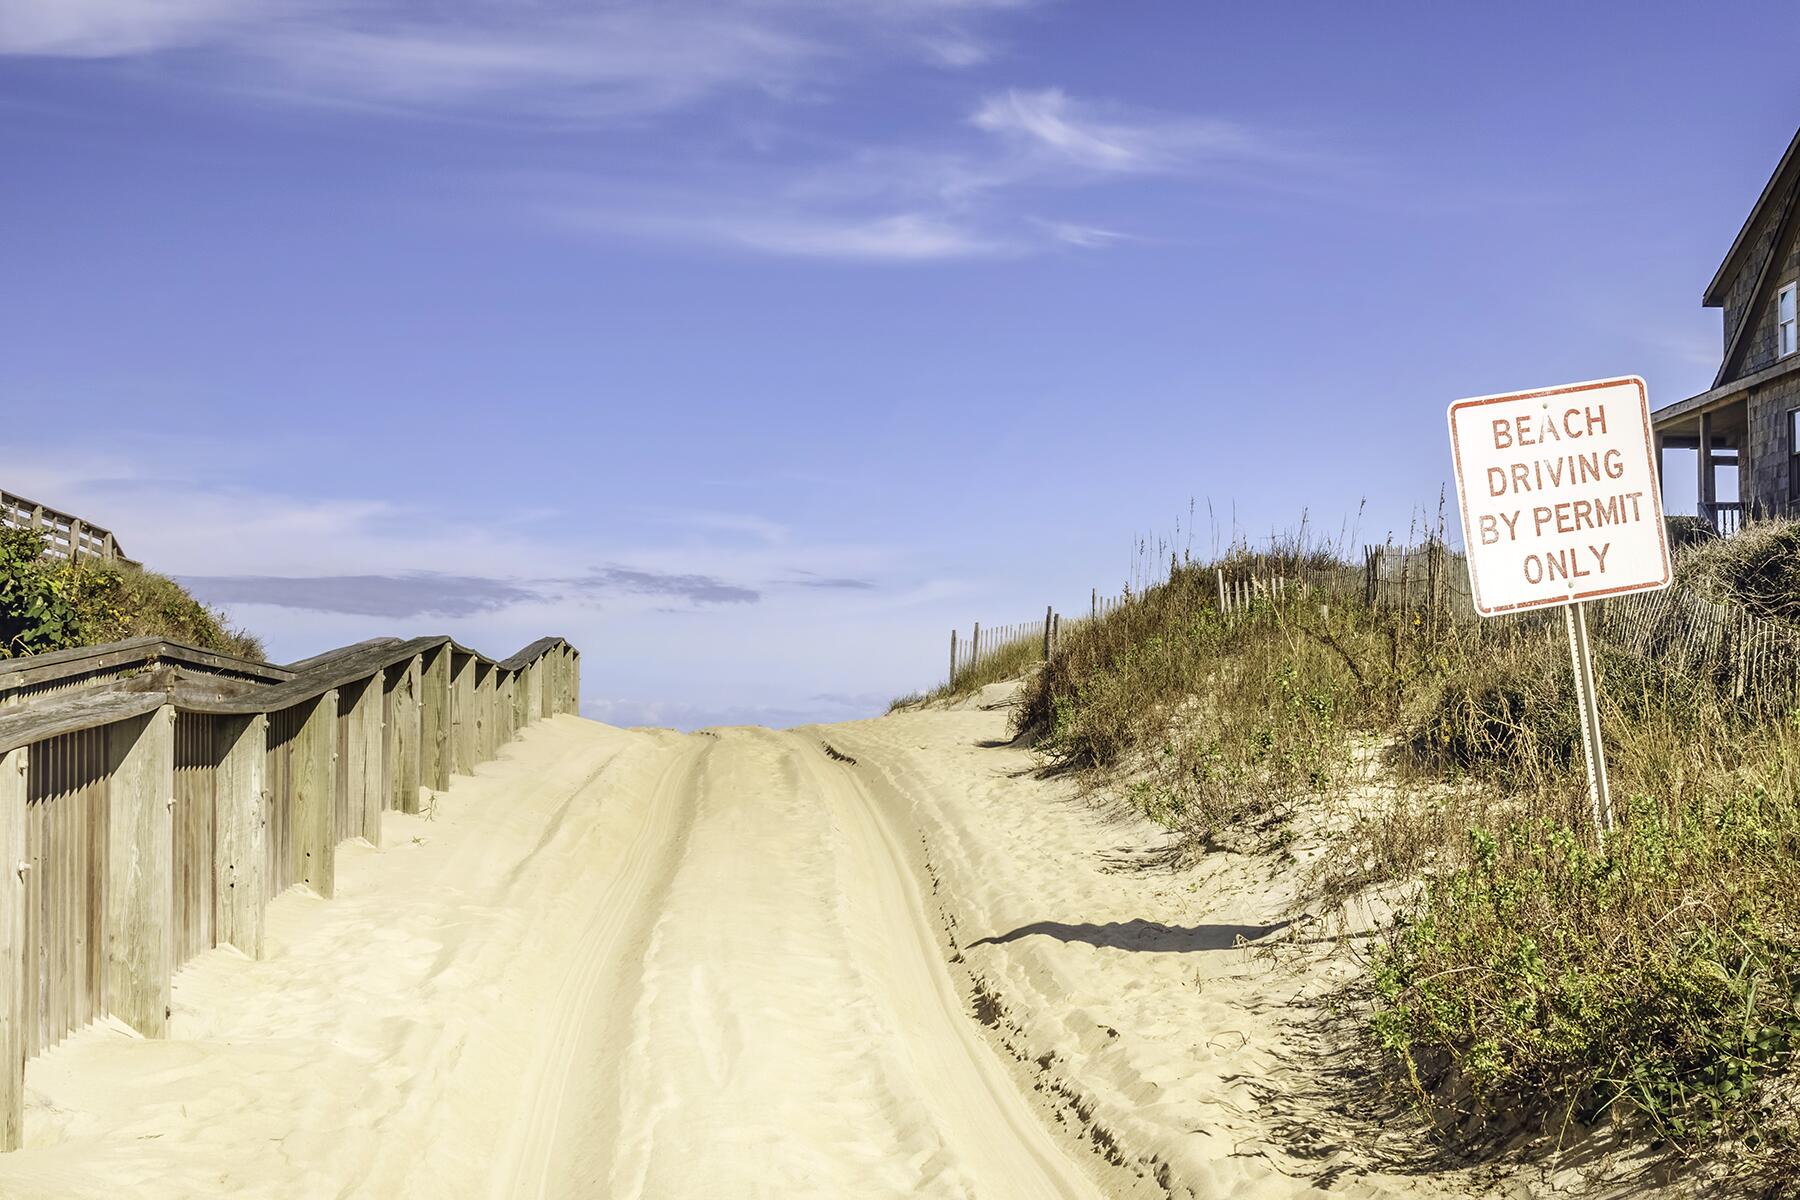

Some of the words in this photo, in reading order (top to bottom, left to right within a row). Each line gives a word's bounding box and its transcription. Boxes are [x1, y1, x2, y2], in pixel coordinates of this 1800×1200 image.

[1492, 405, 1607, 449] BEACH
[1487, 449, 1624, 497] DRIVING
[1479, 510, 1521, 545] BY
[1533, 492, 1643, 537] PERMIT
[1523, 543, 1610, 584] ONLY
